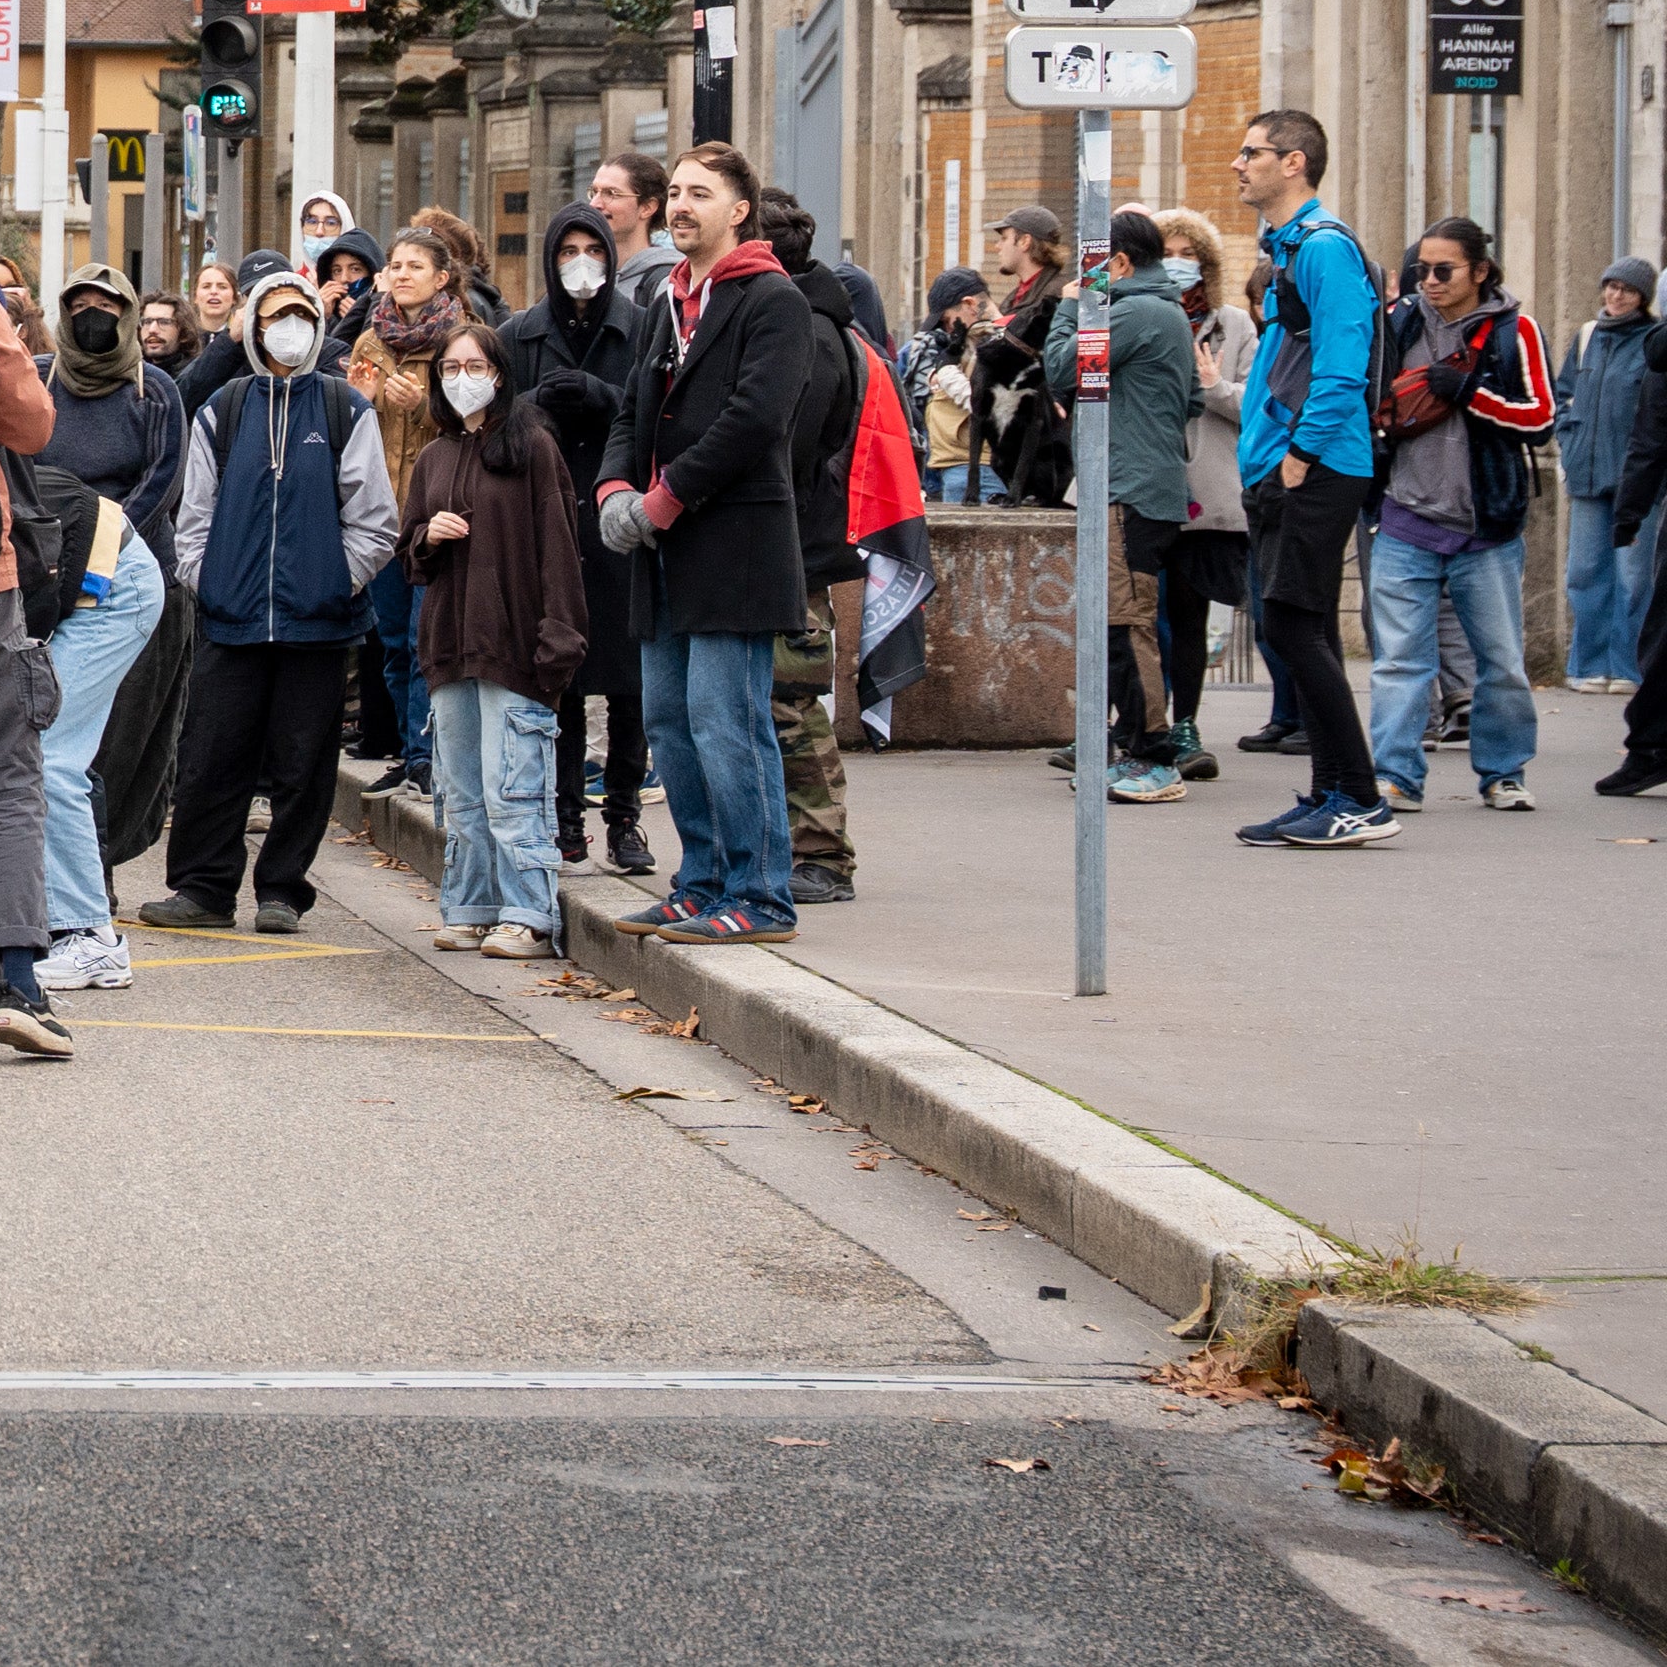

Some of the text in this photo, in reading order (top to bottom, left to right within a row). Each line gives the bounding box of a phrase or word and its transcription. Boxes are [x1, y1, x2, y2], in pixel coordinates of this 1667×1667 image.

[1460, 23, 1495, 35] Allée
[1439, 39, 1515, 53] HANNAH
[1440, 57, 1512, 72] ARENDT
[1454, 76, 1498, 89] NORD
